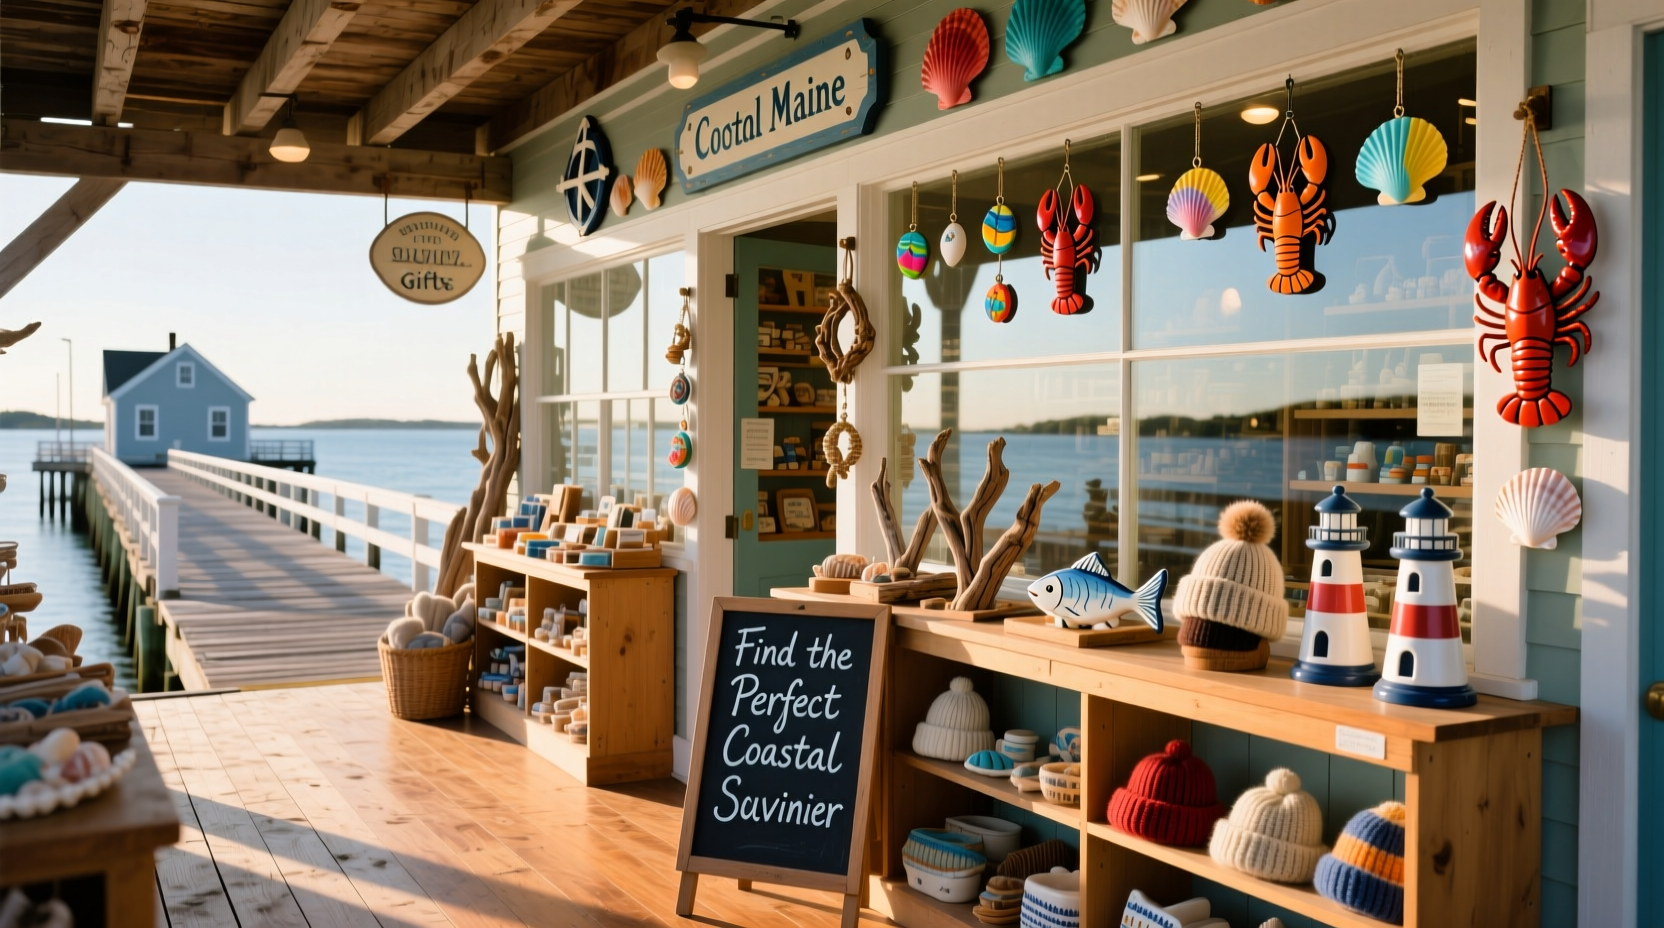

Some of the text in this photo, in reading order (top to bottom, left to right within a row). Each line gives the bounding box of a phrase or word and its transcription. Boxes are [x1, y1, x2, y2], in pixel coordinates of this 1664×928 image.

[695, 75, 846, 160] Cootal Maine
[400, 271, 454, 291] Gifts
[735, 626, 853, 670] Find the
[731, 673, 842, 734] Perfect
[723, 724, 843, 774] Coastal
[713, 775, 844, 829] Savinier
